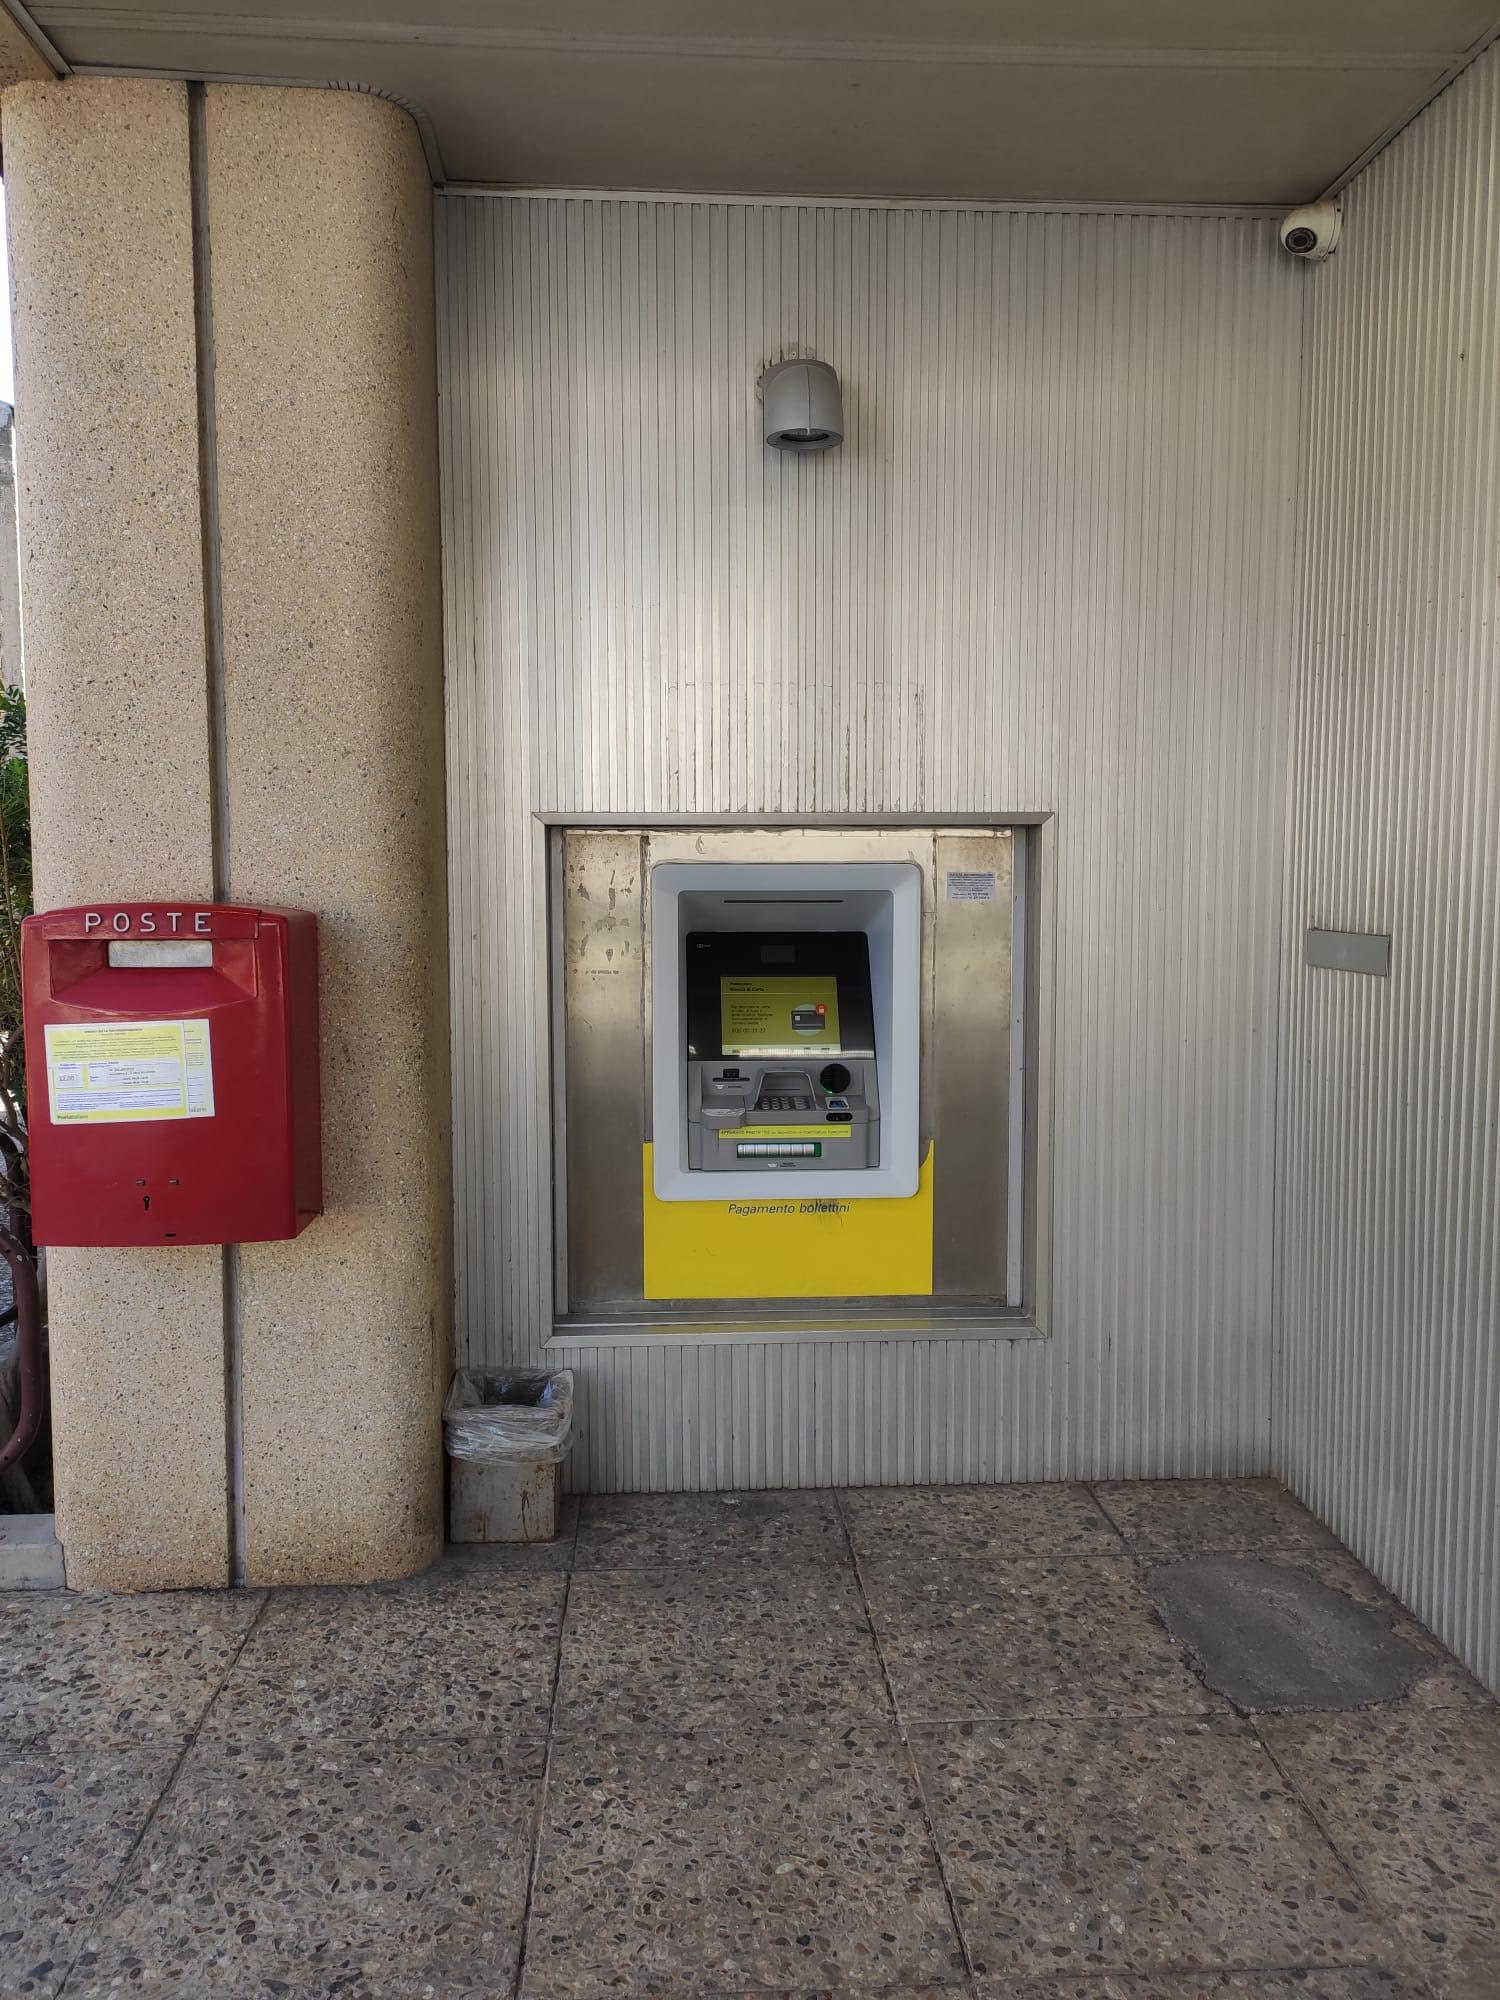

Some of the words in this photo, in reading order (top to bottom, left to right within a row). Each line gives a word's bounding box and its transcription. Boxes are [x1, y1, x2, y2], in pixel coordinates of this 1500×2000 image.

[85, 912, 212, 933] POSTE
[728, 1203, 796, 1217] Pagamento
[799, 1202, 851, 1214] bollettini
